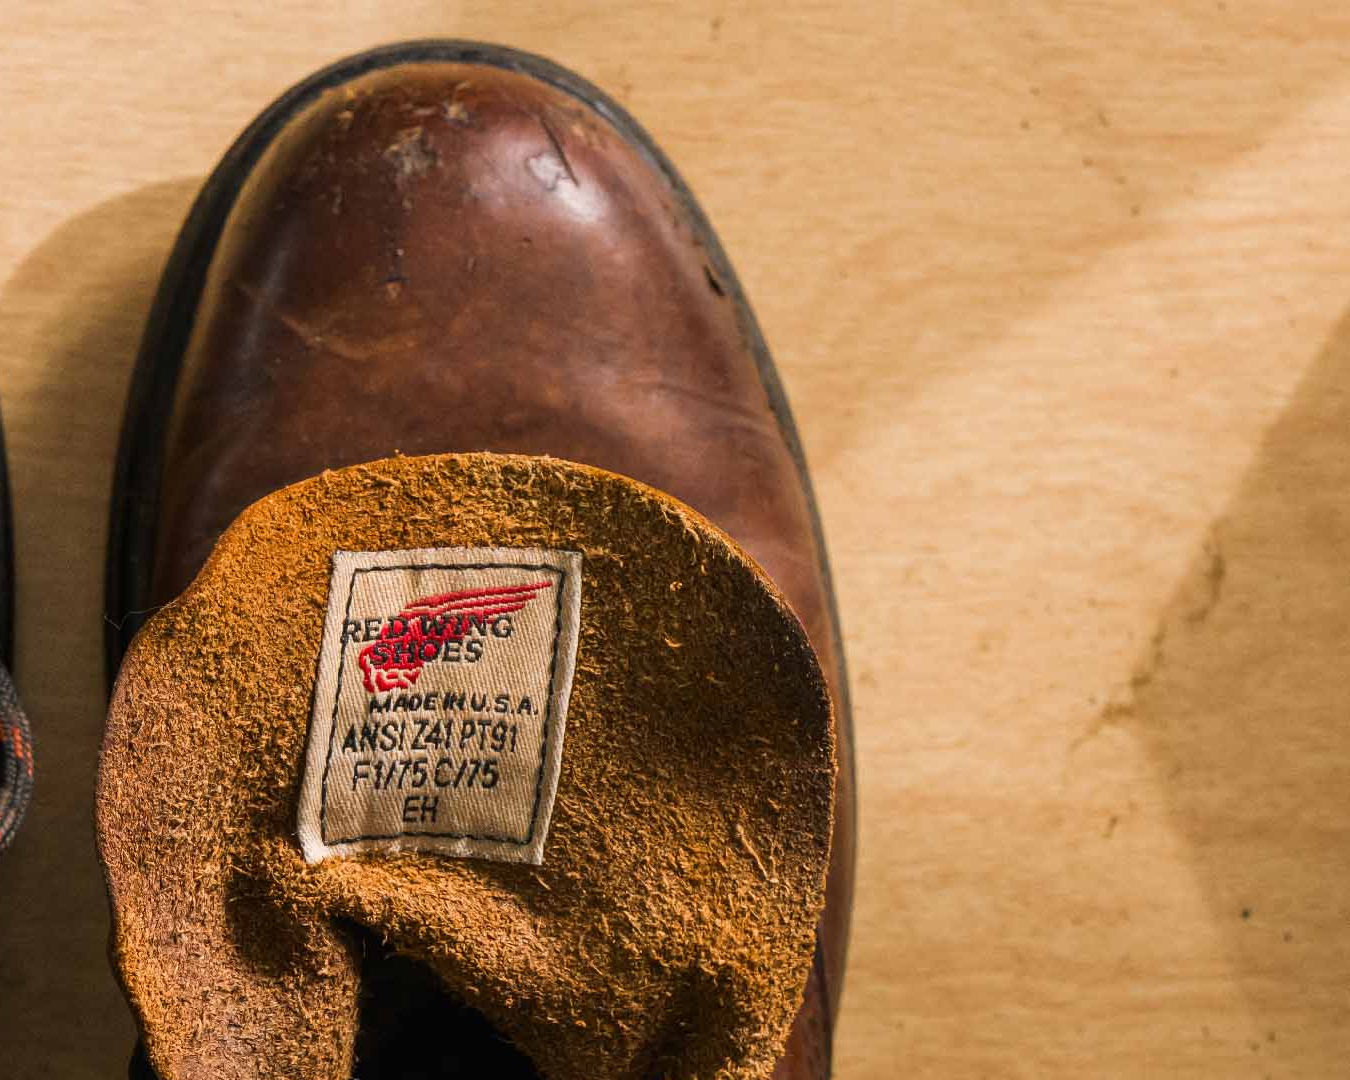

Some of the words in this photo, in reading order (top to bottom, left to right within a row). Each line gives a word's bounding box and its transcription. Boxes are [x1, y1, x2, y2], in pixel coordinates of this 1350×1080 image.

[341, 615, 411, 643] RED
[421, 615, 514, 639] WING
[368, 639, 484, 666] SHOES
[369, 694, 438, 713] MADE
[442, 693, 466, 711] IN
[342, 718, 407, 754] ANSI
[410, 719, 454, 752] Z41
[458, 719, 519, 753] PT91
[433, 758, 500, 790] C/75
[402, 796, 439, 823] EH
